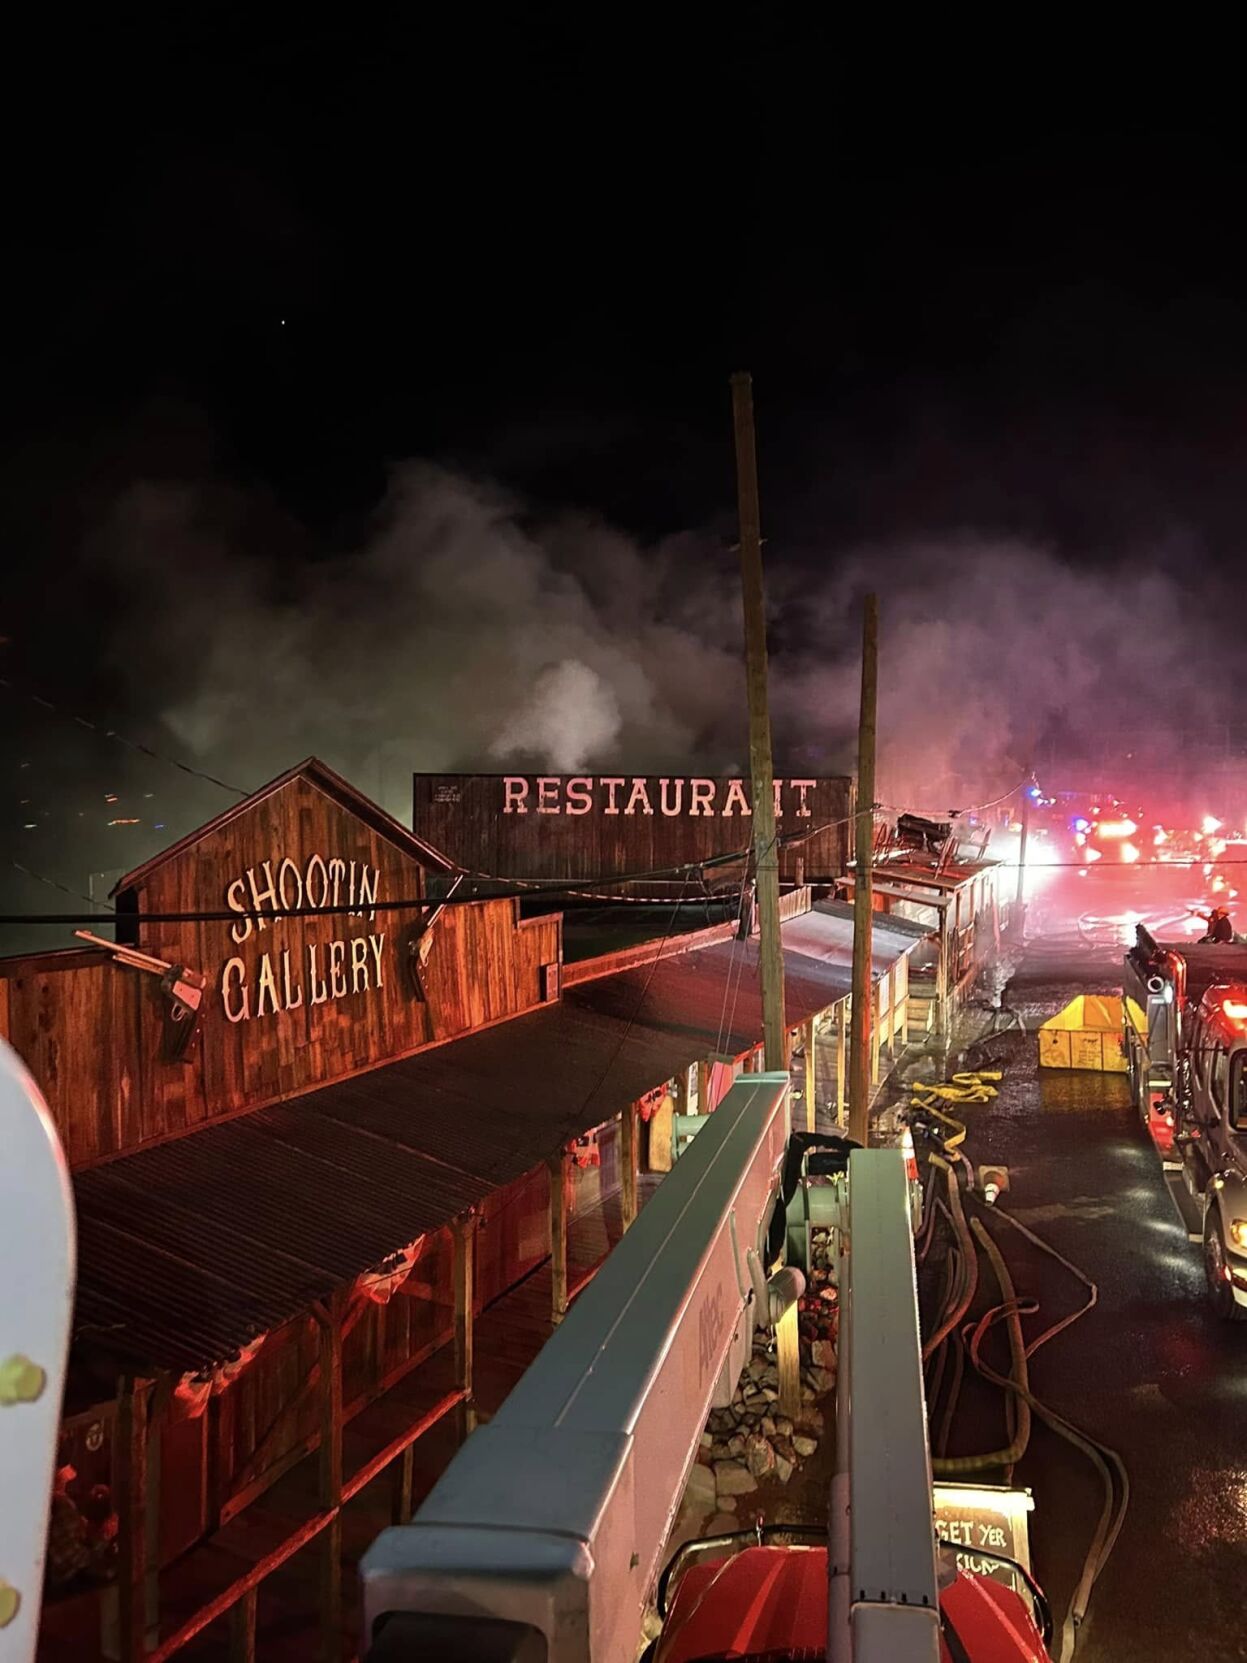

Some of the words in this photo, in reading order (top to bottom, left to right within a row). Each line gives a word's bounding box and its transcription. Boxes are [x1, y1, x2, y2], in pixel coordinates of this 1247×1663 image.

[227, 853, 381, 944] SHOOTIN
[221, 932, 386, 1023] GALLERY
[935, 1519, 974, 1546] GET
[979, 1524, 1007, 1548] YER
